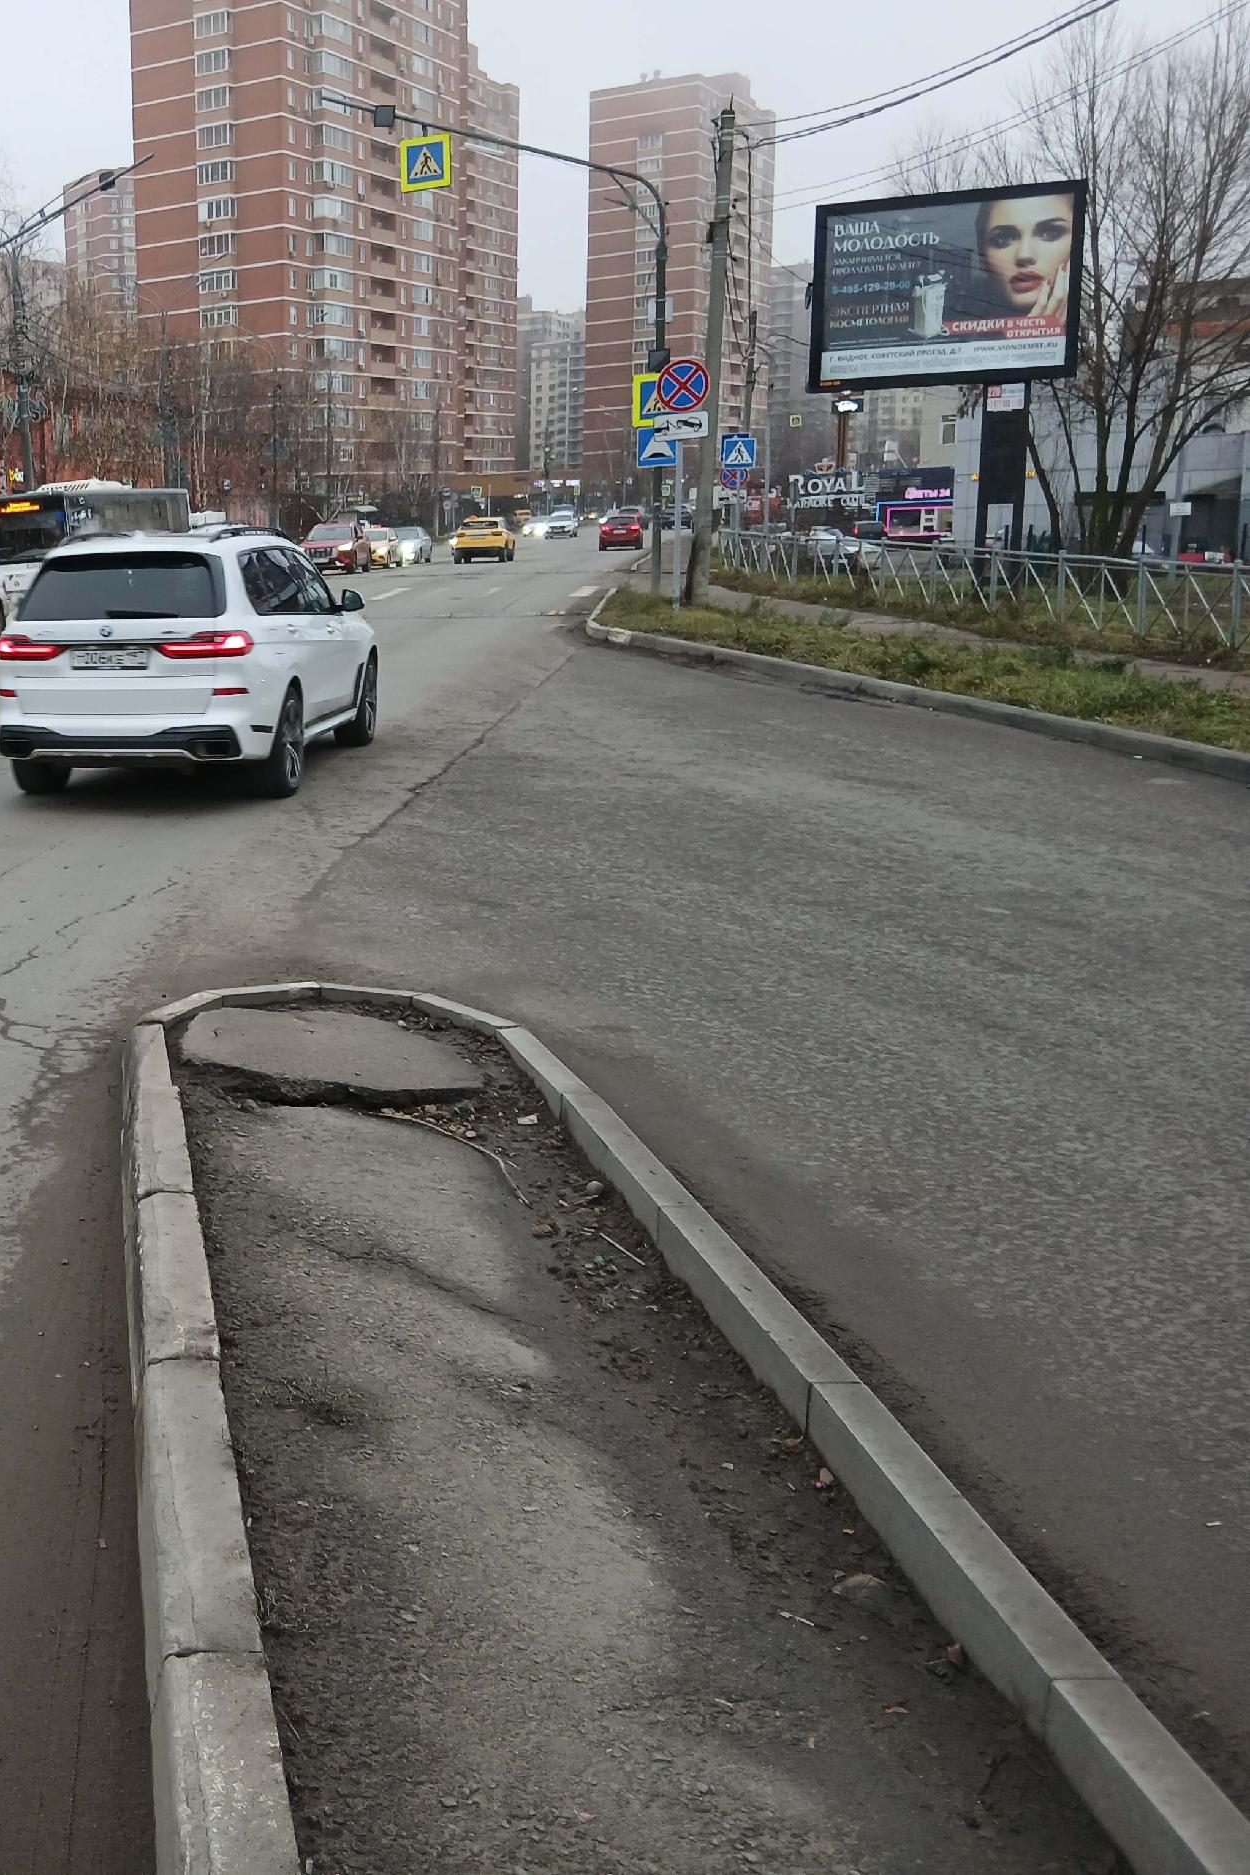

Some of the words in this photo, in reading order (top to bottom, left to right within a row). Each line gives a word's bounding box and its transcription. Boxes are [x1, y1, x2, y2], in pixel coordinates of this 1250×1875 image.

[834, 221, 880, 238] ВАША
[833, 232, 940, 253] МОЛОДОСТЬ
[830, 302, 910, 317] ЭКСПЕРТНАЯ
[952, 319, 1005, 332] СКИДКИ
[1016, 318, 1046, 327] ЧЕСТЬ
[1006, 326, 1062, 338] ОТКРЫТИЯ
[788, 470, 866, 494] ROYAL
